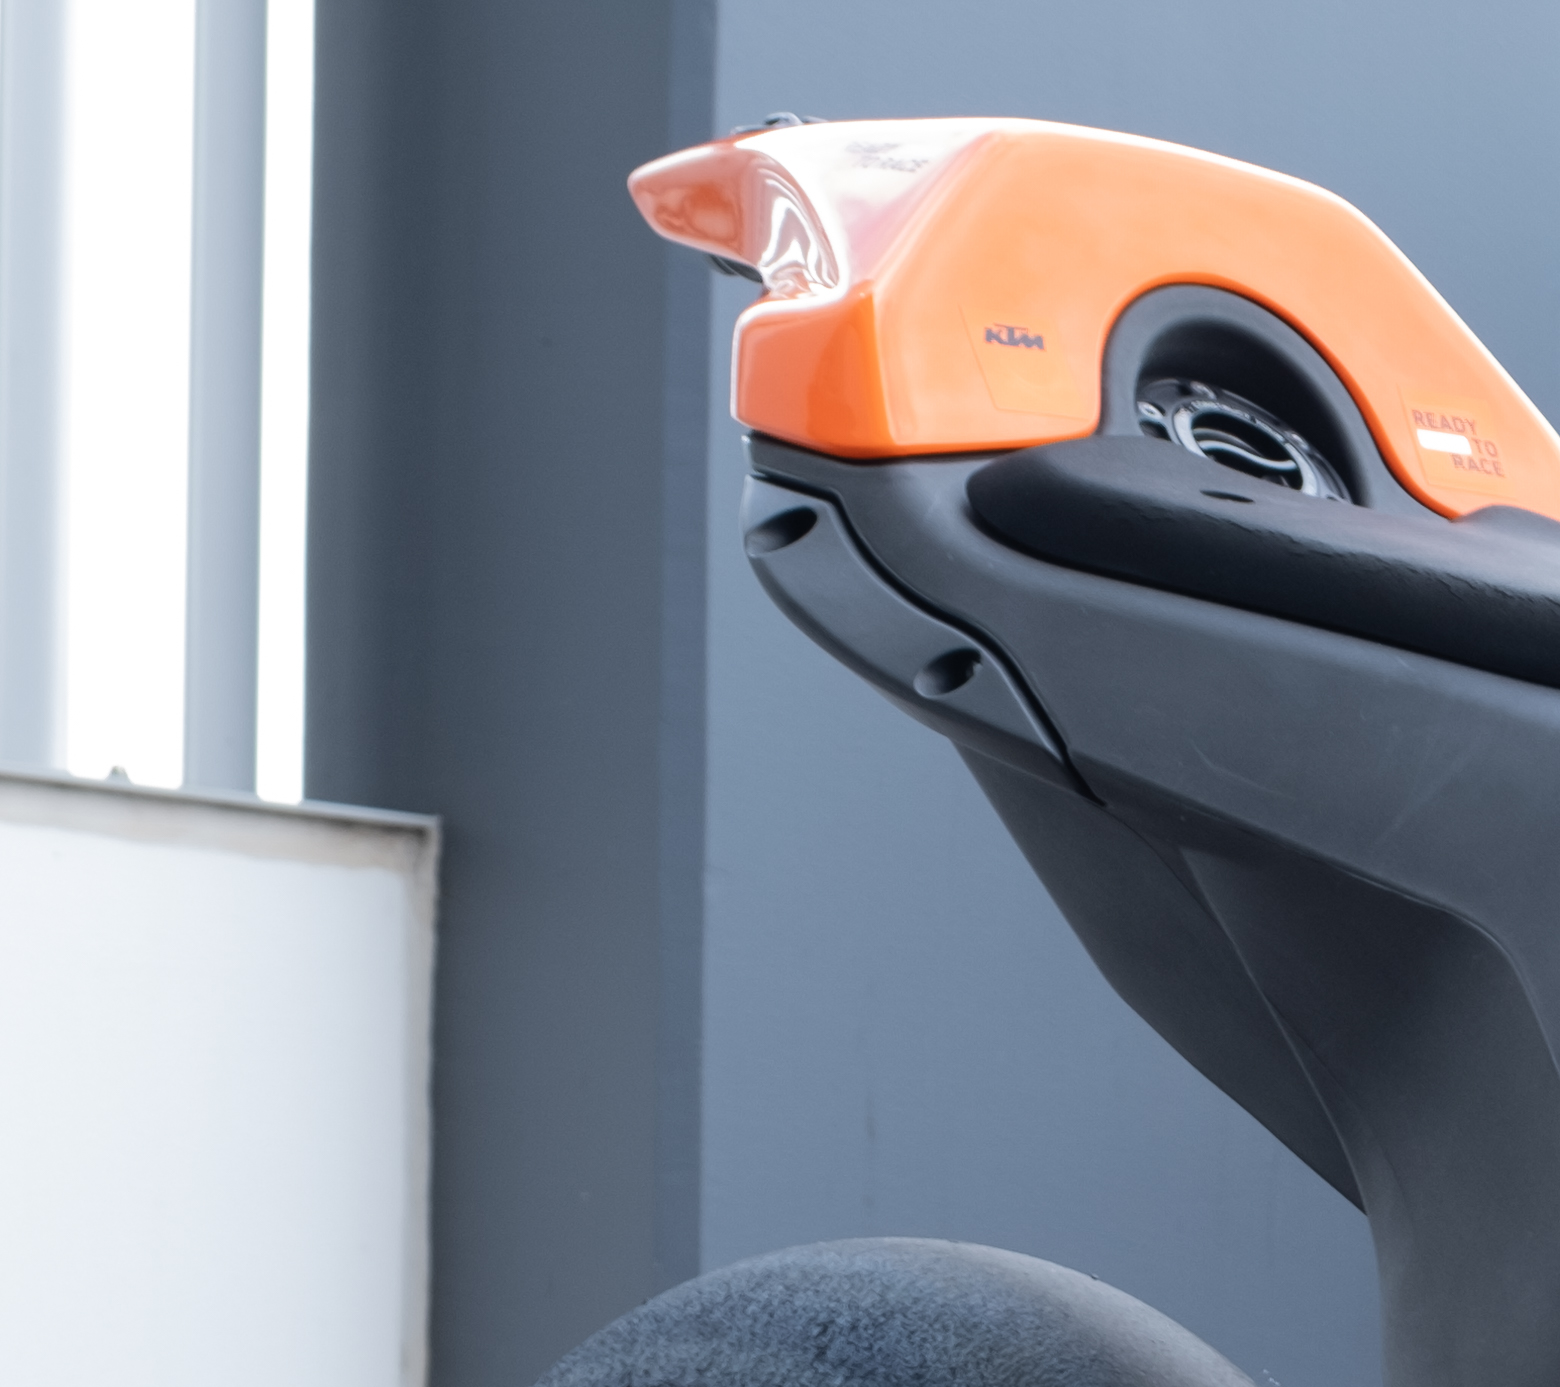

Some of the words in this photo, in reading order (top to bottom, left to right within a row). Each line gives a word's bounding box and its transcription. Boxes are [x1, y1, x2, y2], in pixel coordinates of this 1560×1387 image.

[984, 322, 1046, 350] KTM
[1411, 408, 1477, 435] READY
[1471, 436, 1499, 458] TO
[1450, 452, 1506, 479] RACE
